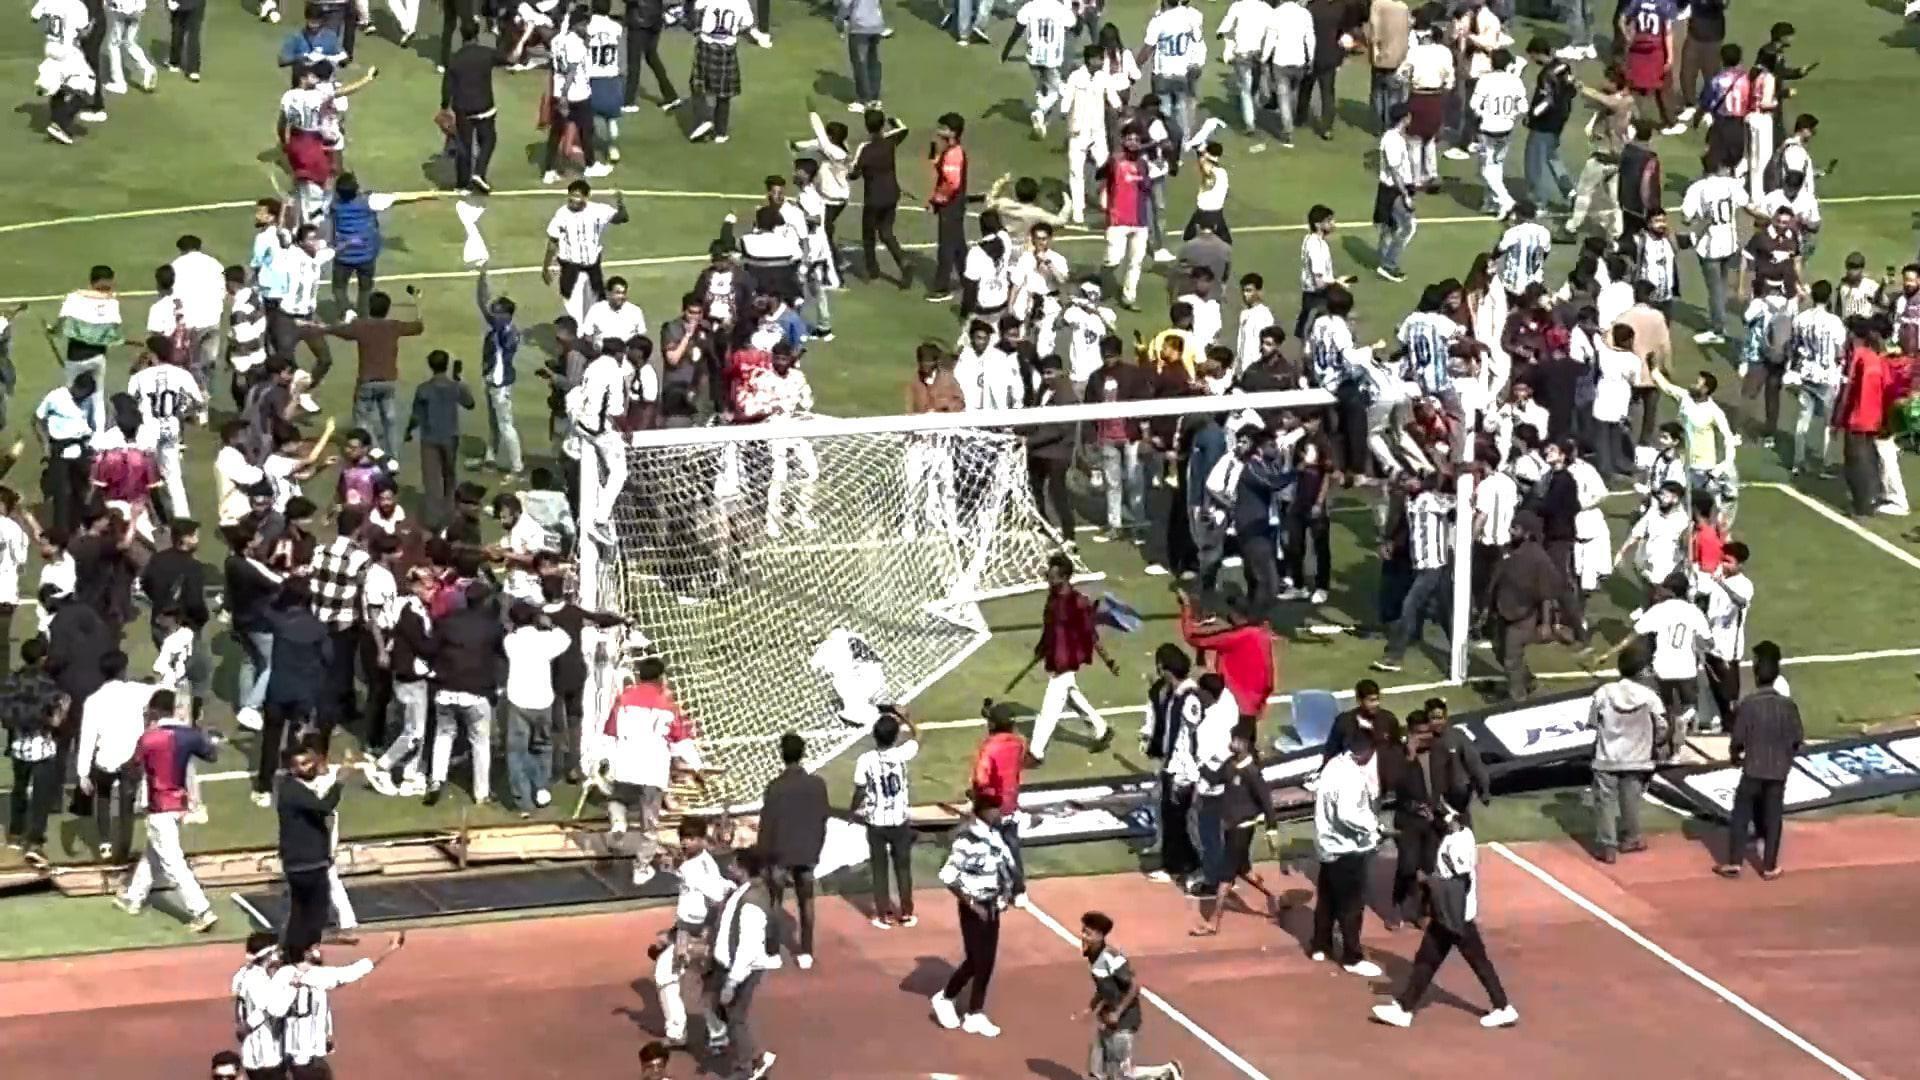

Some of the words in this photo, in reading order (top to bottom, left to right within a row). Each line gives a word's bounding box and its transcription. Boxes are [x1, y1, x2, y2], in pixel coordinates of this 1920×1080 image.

[713, 8, 736, 31] 10
[590, 44, 616, 66] 10
[1491, 96, 1513, 116] 10
[149, 390, 175, 417] 10
[879, 772, 901, 799] 10
